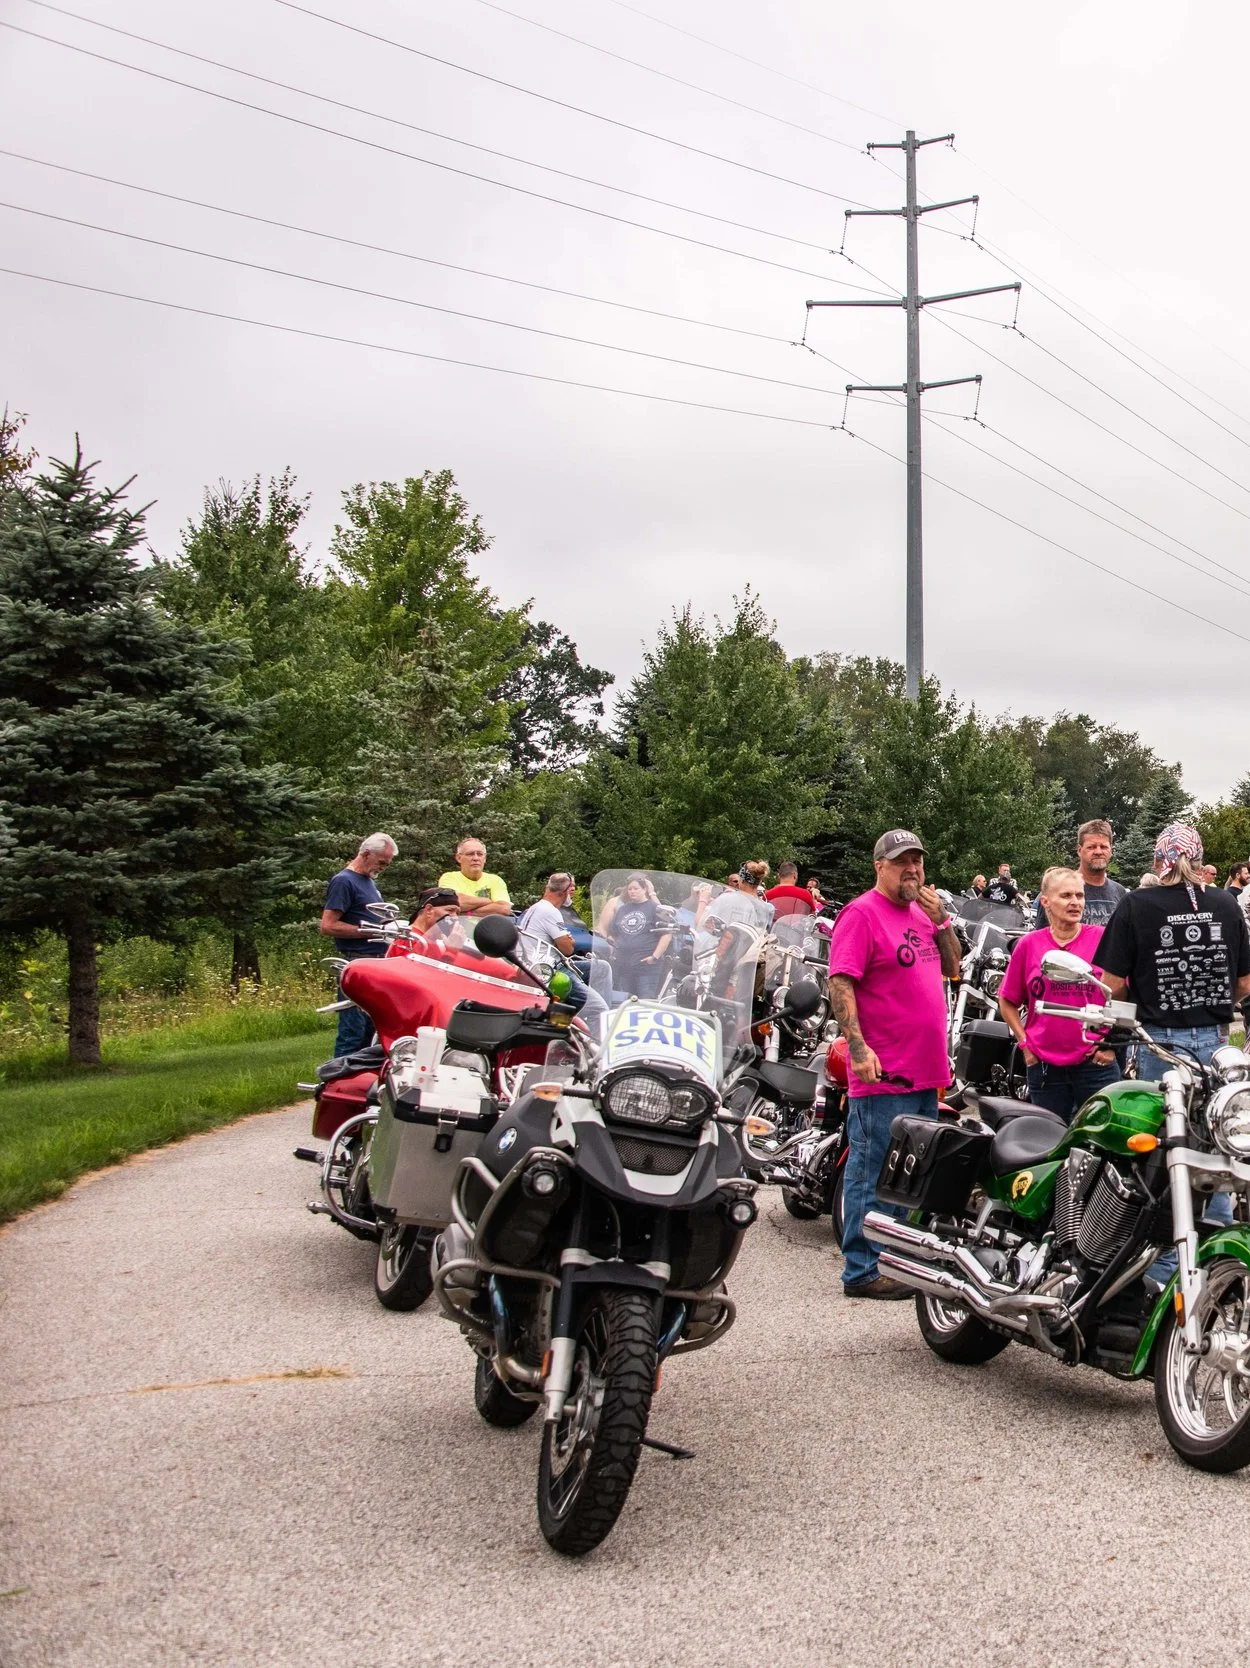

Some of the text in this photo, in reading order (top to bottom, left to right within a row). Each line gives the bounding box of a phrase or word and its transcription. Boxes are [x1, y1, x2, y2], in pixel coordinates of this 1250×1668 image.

[1167, 912, 1213, 922] DISCOVERY
[629, 1010, 706, 1043] FOR
[614, 1028, 712, 1070] SALE
